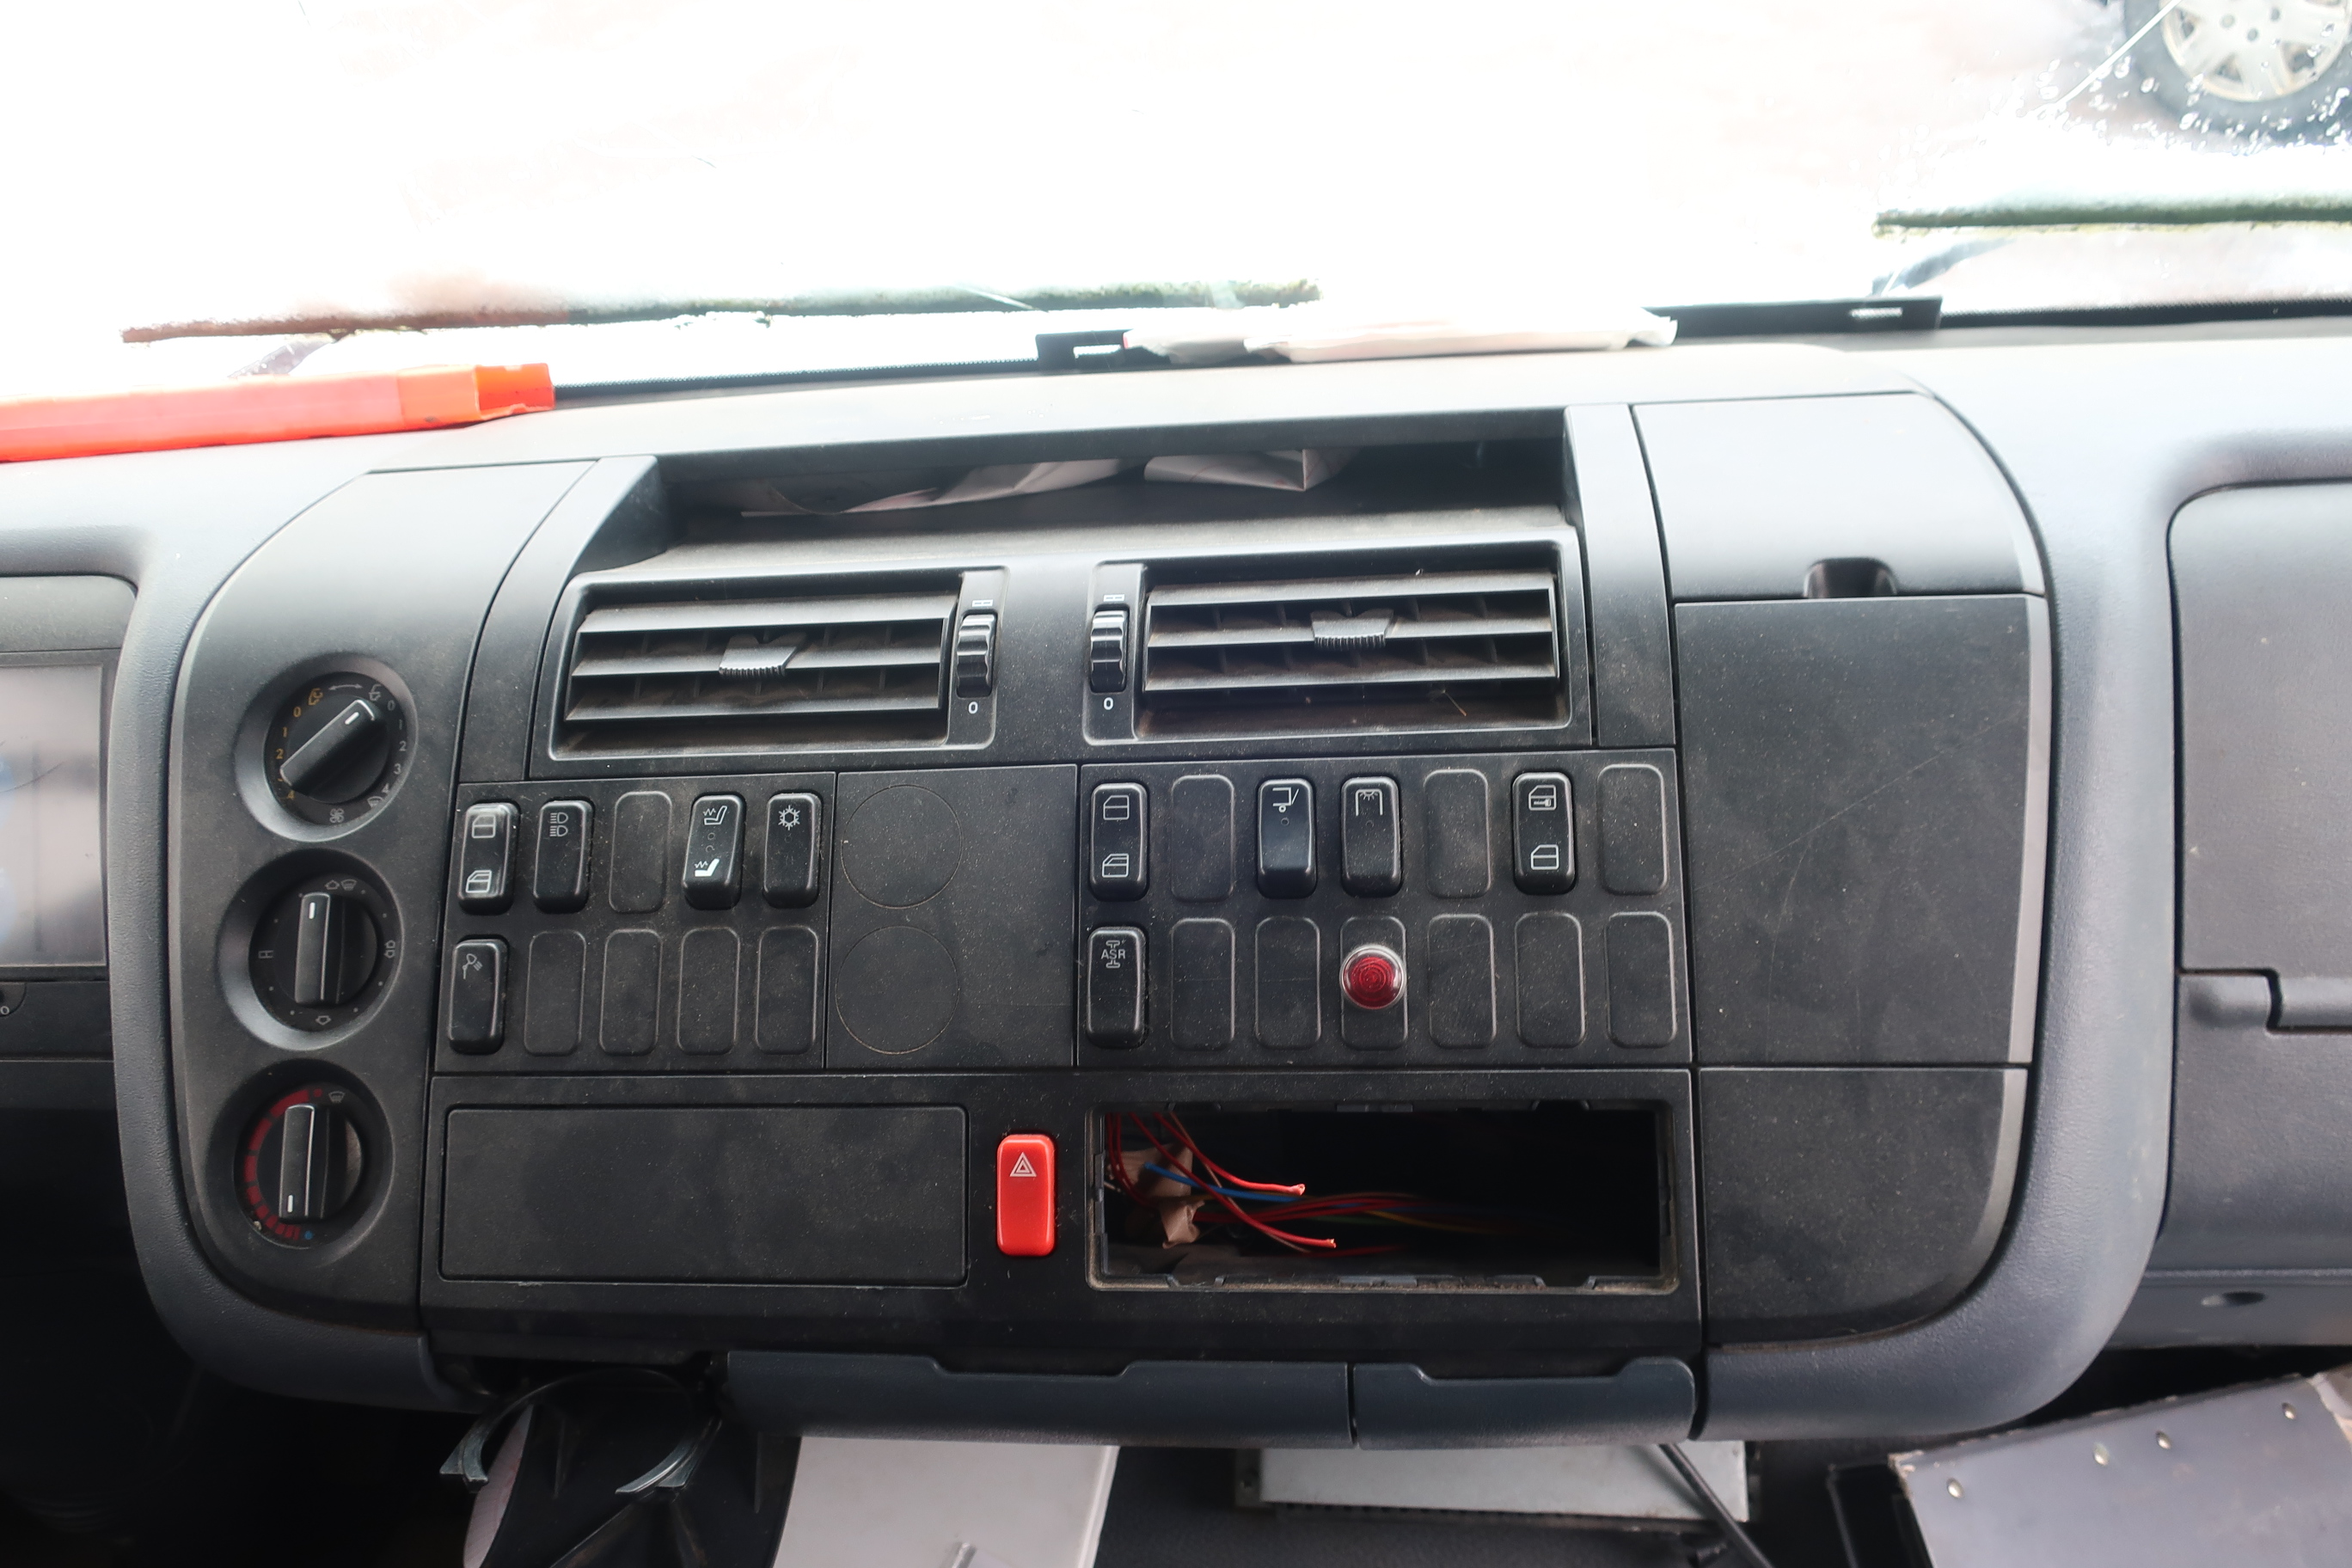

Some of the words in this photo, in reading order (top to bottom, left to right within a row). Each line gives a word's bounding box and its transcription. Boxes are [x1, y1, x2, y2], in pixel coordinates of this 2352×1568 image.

[968, 701, 978, 714] 0
[1103, 696, 1114, 710] 0
[293, 706, 302, 718] 0
[282, 726, 288, 738] 1
[399, 740, 407, 752] 2
[275, 748, 285, 760] 2
[394, 763, 401, 775] 3
[1100, 948, 1126, 960] ASR
